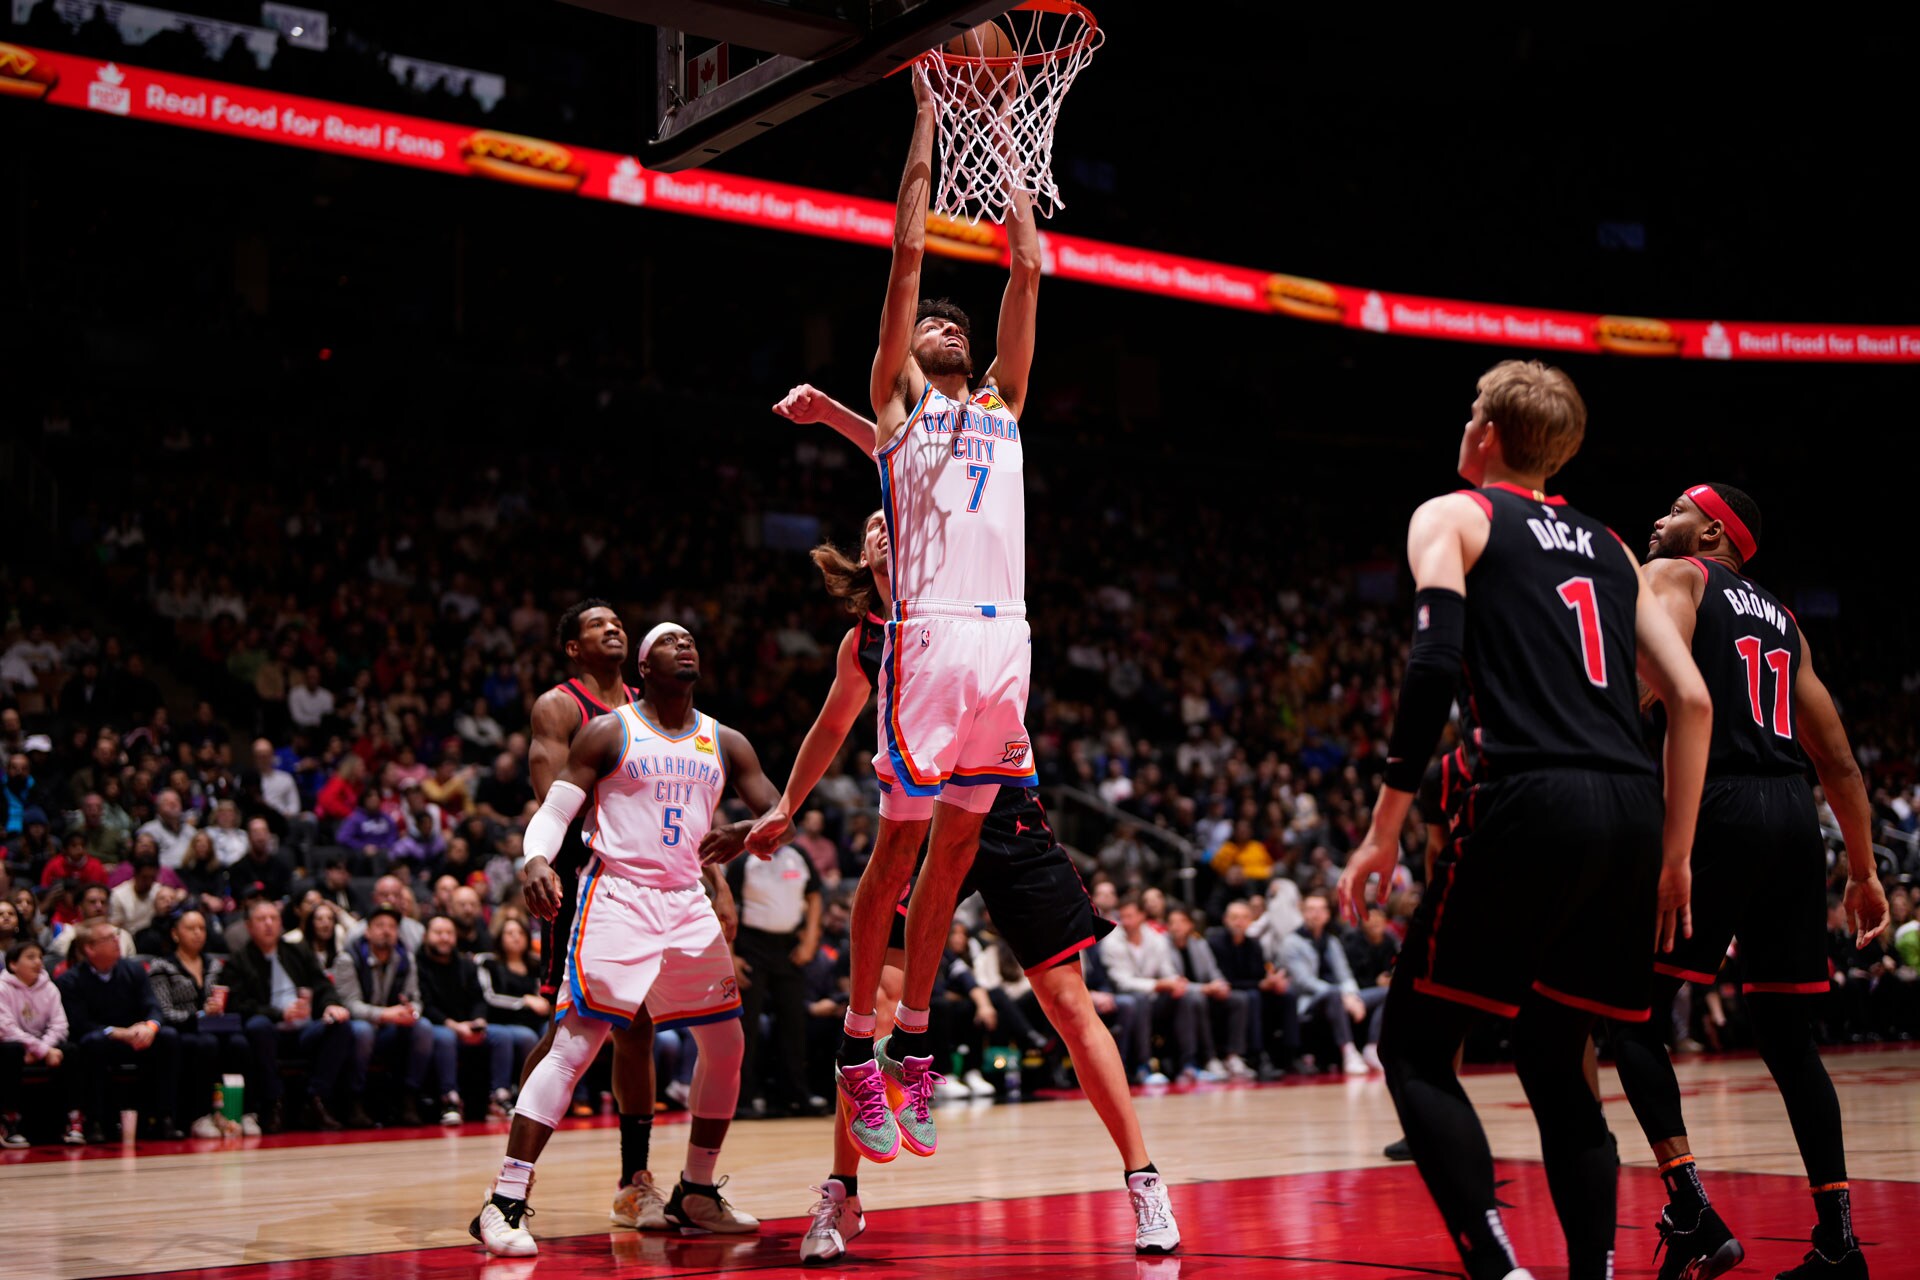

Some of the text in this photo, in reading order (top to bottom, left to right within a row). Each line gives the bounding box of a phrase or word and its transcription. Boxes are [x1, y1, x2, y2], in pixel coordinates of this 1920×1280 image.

[146, 84, 206, 118] Real
[211, 95, 278, 131] Food
[281, 107, 320, 138] for
[323, 114, 381, 149] Real
[384, 125, 445, 160] Fans
[654, 175, 702, 204] Real
[706, 183, 760, 215] Food
[794, 197, 842, 229] Real
[923, 409, 1018, 442] OKLAHOMA
[951, 435, 995, 464] CITY
[966, 463, 990, 513] 7
[1526, 518, 1595, 560] DICK
[1556, 576, 1608, 688] 1
[1723, 588, 1787, 636] BROWN
[1734, 635, 1792, 739] 11
[626, 756, 720, 789] OKLAHOMA
[655, 780, 694, 805] CITY
[661, 805, 684, 848] 5
